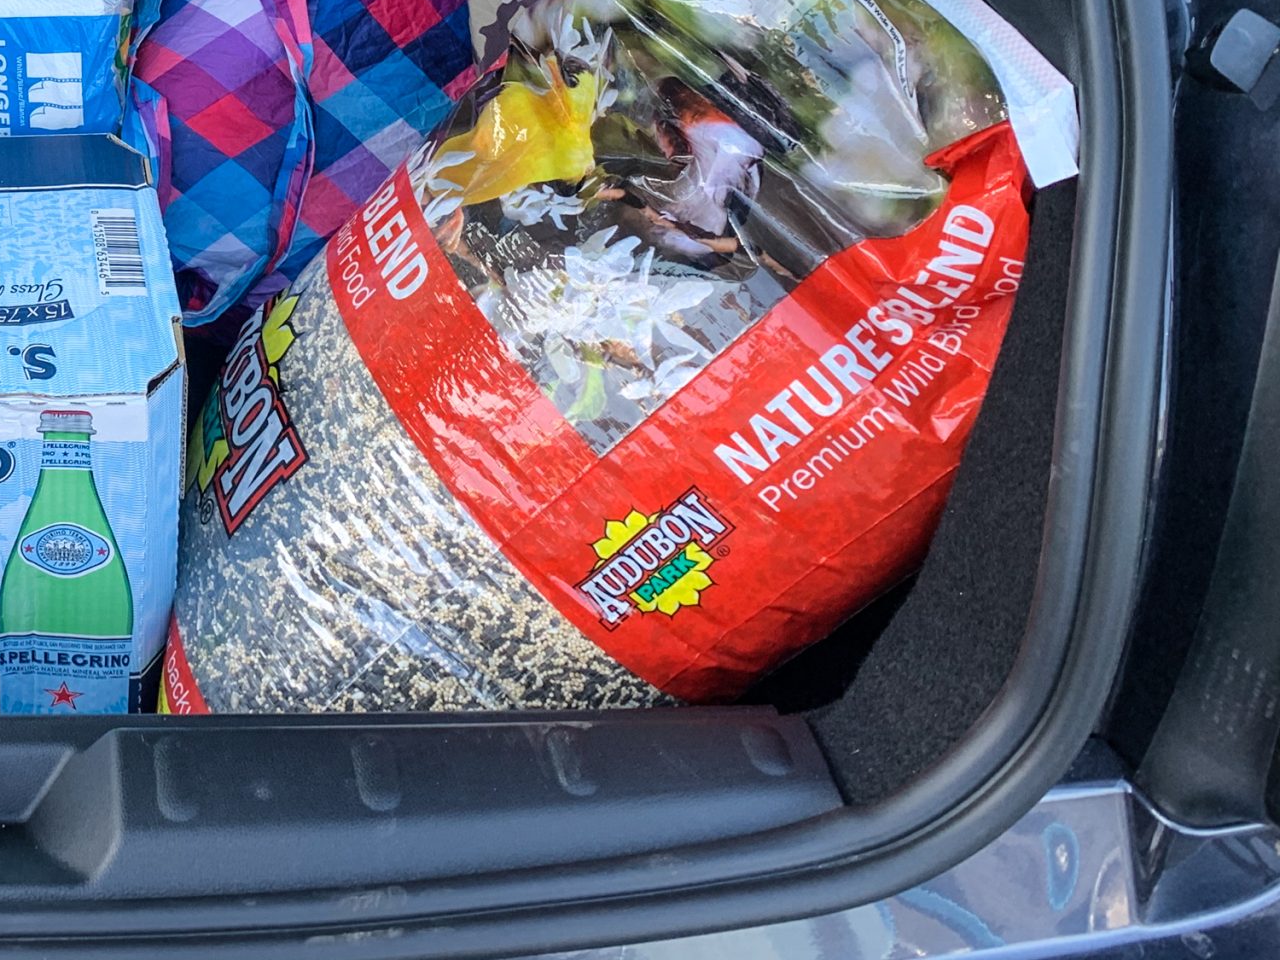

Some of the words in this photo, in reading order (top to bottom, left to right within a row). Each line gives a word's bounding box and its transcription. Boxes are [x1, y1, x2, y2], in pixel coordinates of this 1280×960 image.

[93, 224, 106, 248] 41508
[362, 181, 429, 301] BLEND
[96, 251, 110, 279] 63446
[339, 244, 377, 310] Food
[10, 278, 63, 302] Glass
[27, 305, 39, 317] x
[45, 302, 69, 320] 15
[712, 304, 914, 486] NATURE'S
[882, 204, 995, 325] BLEND
[757, 406, 896, 513] Premium
[882, 351, 947, 407] Wild
[927, 304, 981, 356] Bird
[579, 491, 728, 624] AUDUBON
[634, 550, 700, 603] PARK
[5, 664, 39, 672] SPARKLING
